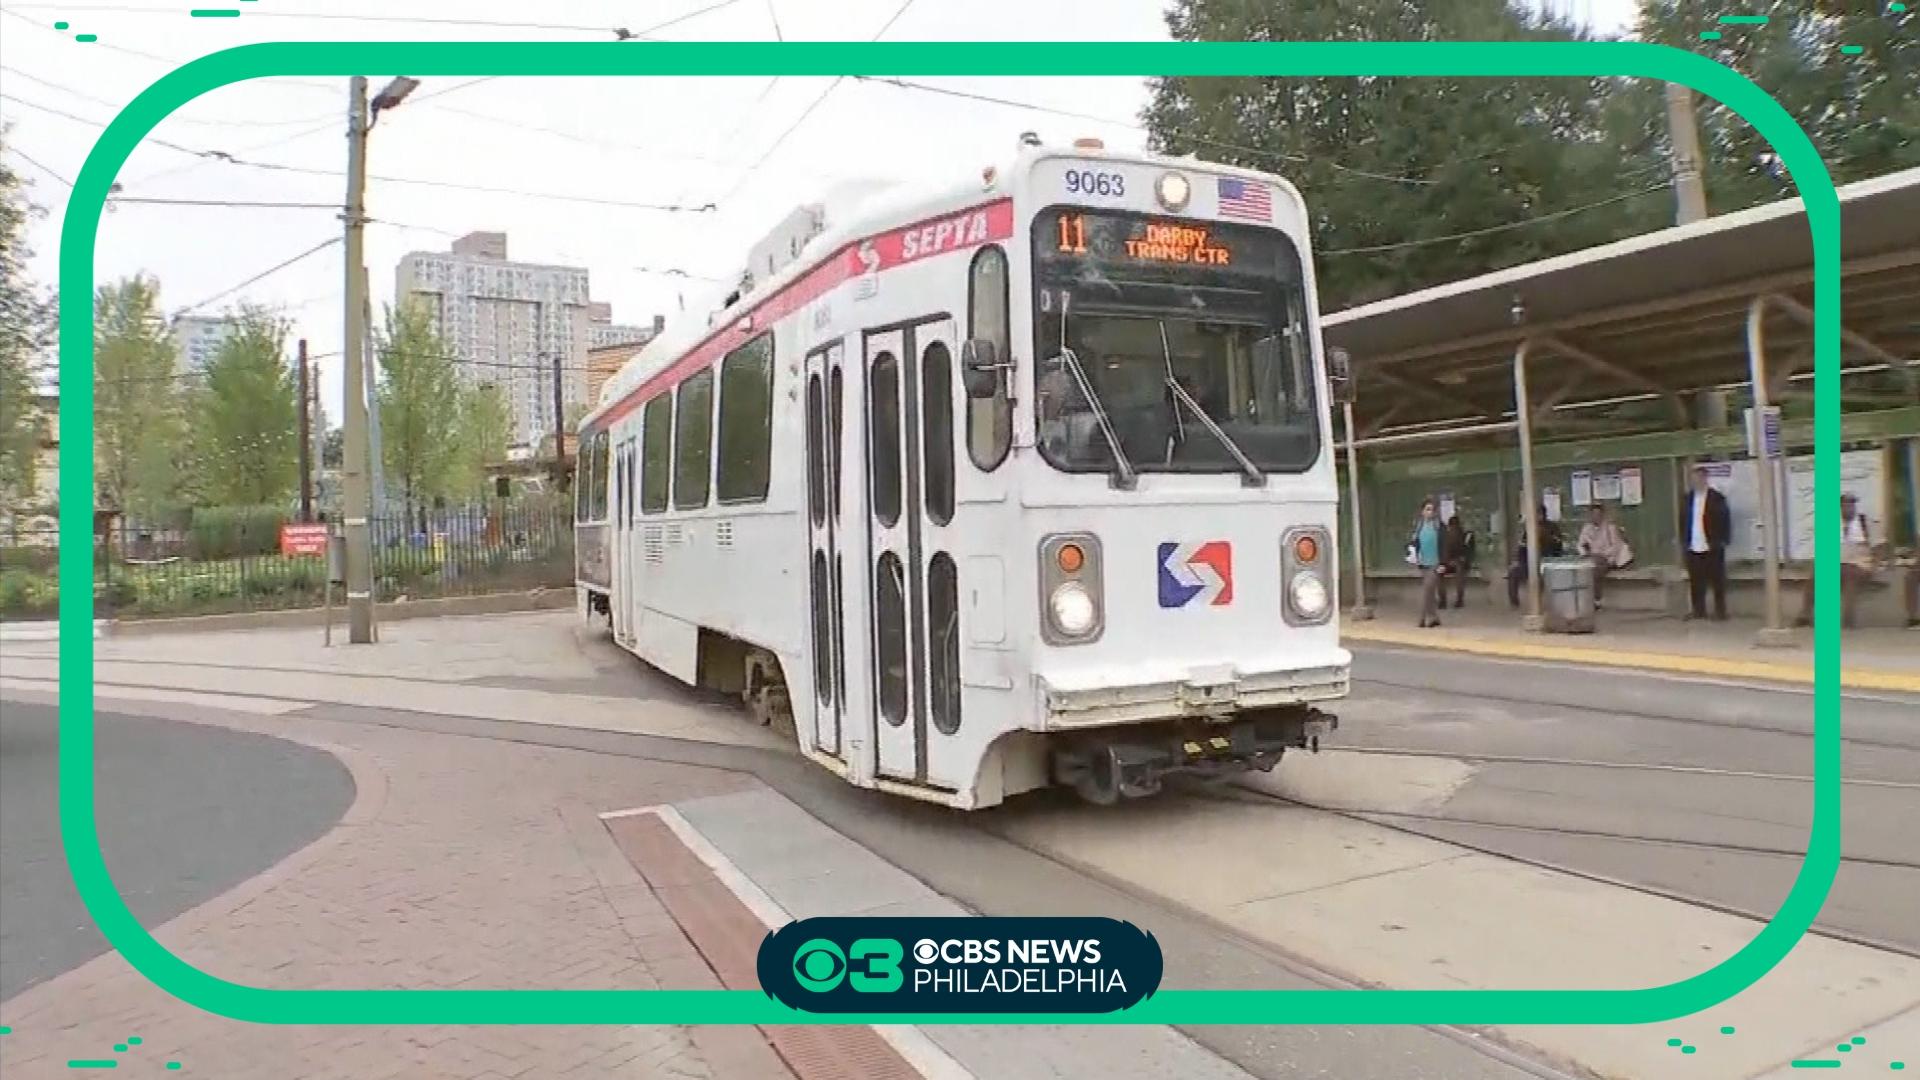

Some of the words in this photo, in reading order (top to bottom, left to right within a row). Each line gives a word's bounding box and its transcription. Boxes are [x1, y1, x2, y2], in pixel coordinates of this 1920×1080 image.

[1065, 169, 1124, 196] 9063
[902, 212, 988, 259] SEPTA
[1058, 213, 1086, 254] 11
[1146, 223, 1207, 245] DARBY
[1126, 240, 1190, 260] TRANS
[1194, 247, 1230, 266] CTR
